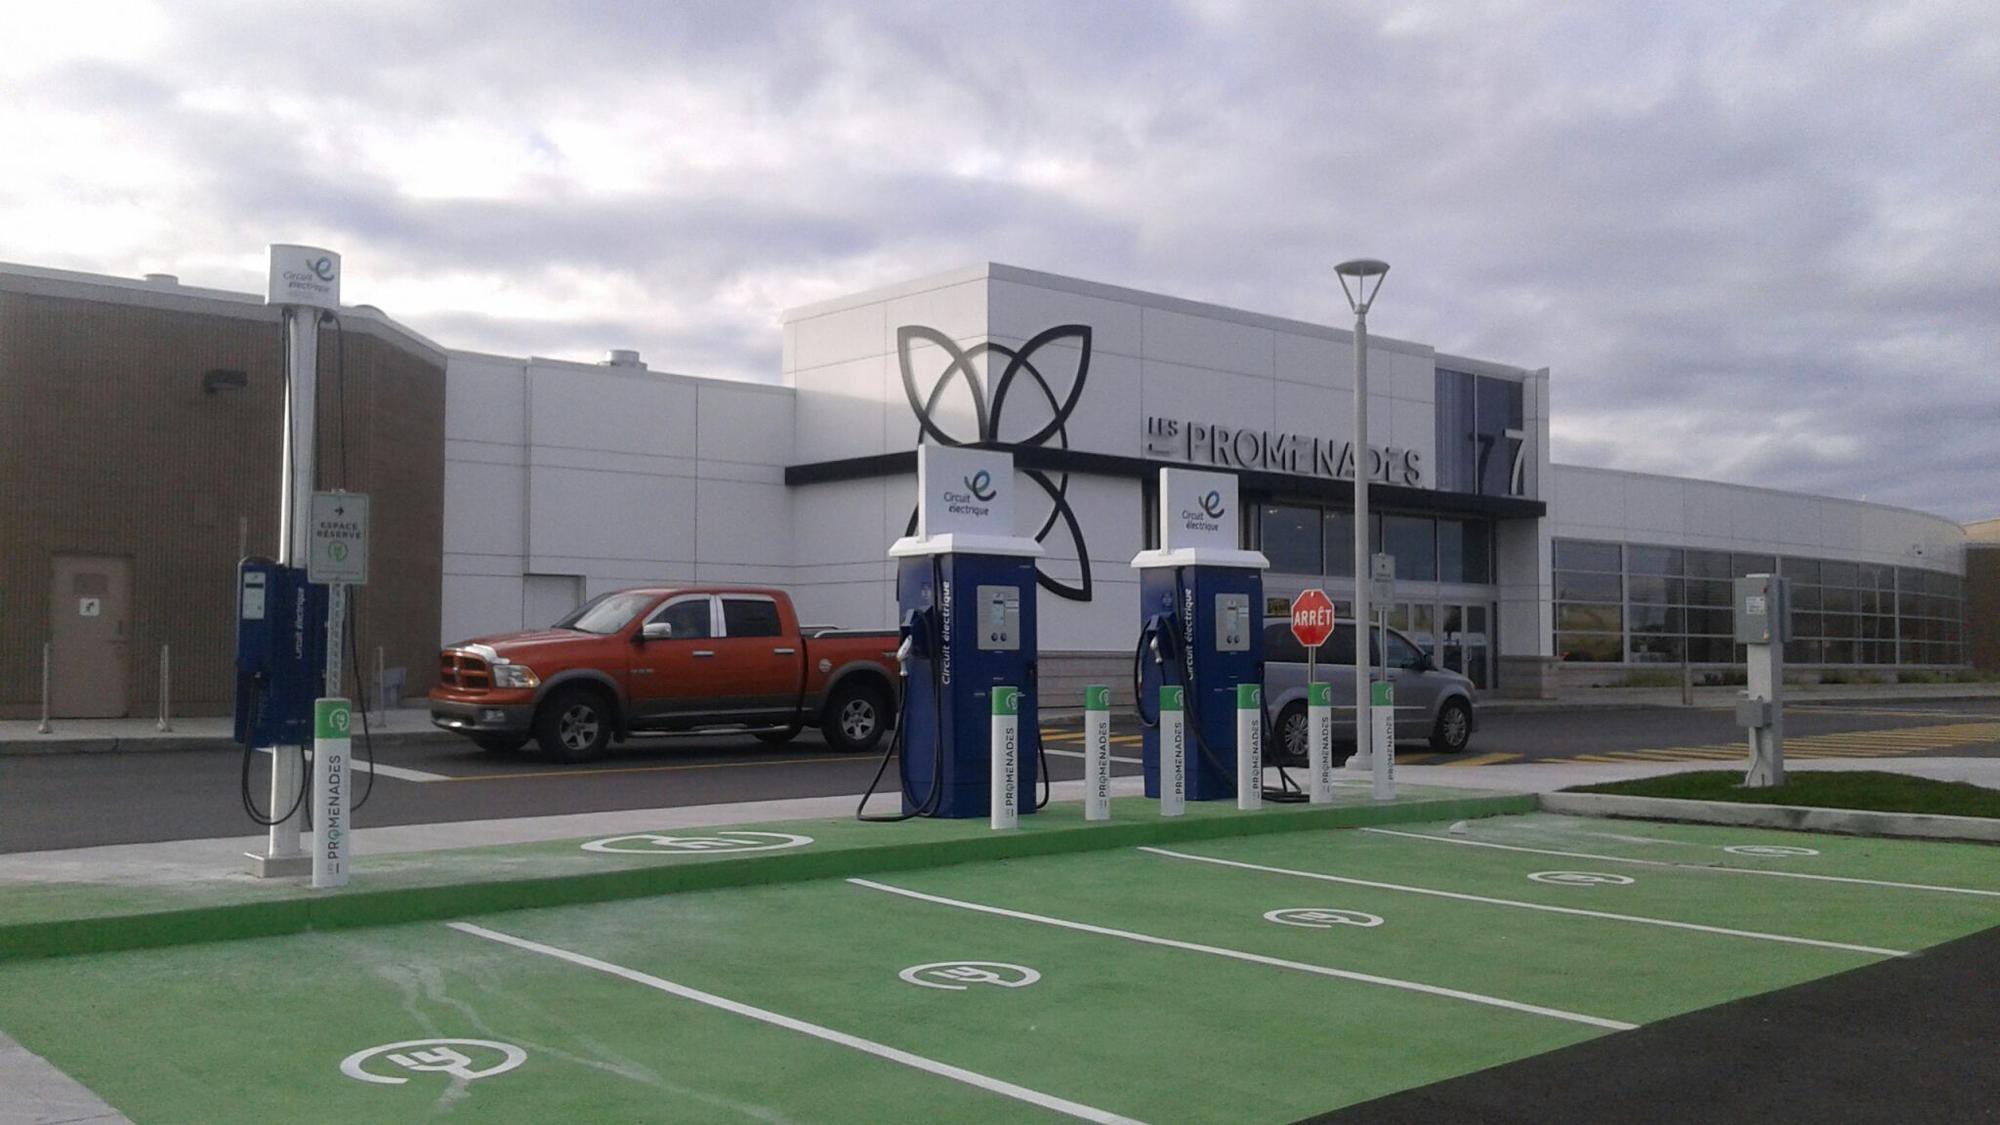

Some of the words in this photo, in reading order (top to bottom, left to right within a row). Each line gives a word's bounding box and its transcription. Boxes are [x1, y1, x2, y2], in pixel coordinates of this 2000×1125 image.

[1148, 416, 1178, 438] LES
[1187, 421, 1421, 487] PROMENADES
[943, 491, 971, 503] Circuit
[948, 503, 989, 517] électrique
[1181, 510, 1204, 521] Circuit
[1294, 606, 1332, 627] ARRÊT
[941, 644, 951, 685] Circuit
[1005, 727, 1015, 806] PROMENADES
[1098, 722, 1108, 798] PROMENADES
[1174, 722, 1183, 795] PROMENADES
[1252, 719, 1260, 790] PROMENADES
[1321, 716, 1330, 784] PROMENADES
[328, 755, 342, 859] PROMENADES
